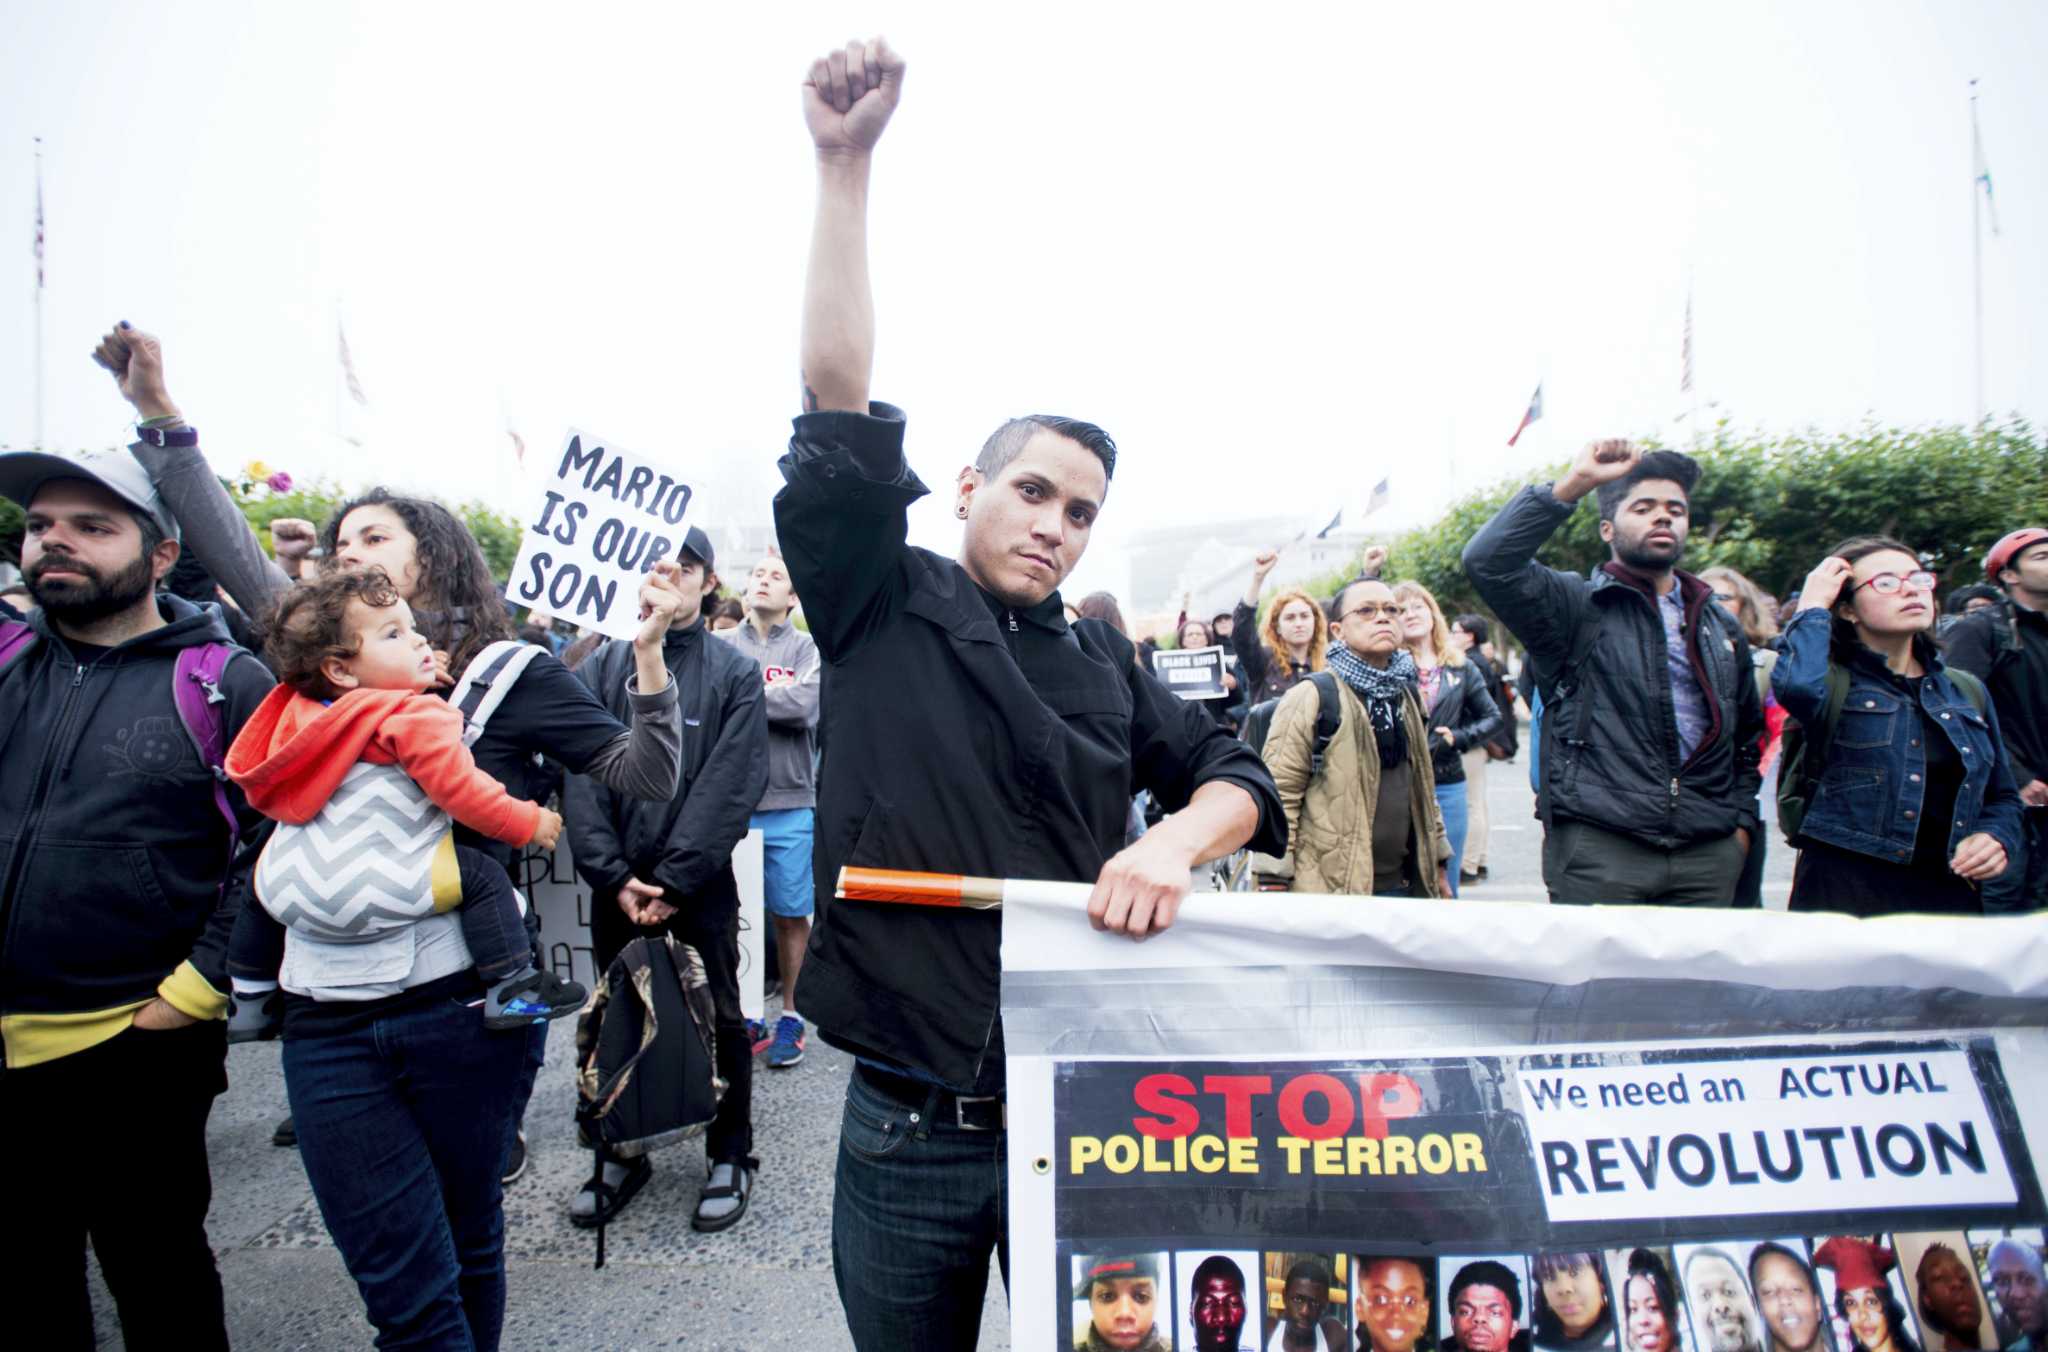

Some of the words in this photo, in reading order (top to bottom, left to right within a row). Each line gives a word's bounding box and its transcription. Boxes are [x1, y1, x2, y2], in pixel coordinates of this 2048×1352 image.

[558, 434, 692, 525] MARIO
[531, 490, 588, 545] IS
[592, 518, 672, 574] OUR
[519, 552, 618, 622] SON
[1132, 1073, 1423, 1142] STOP
[1523, 1077, 1589, 1111] We
[1599, 1072, 1690, 1108] need
[1701, 1075, 1746, 1103] an
[1779, 1061, 1948, 1099] ACTUAL
[1070, 1135, 1260, 1175] POLICE
[1277, 1132, 1489, 1175] TERROR
[1540, 1120, 1988, 1197] REVOLUTION
